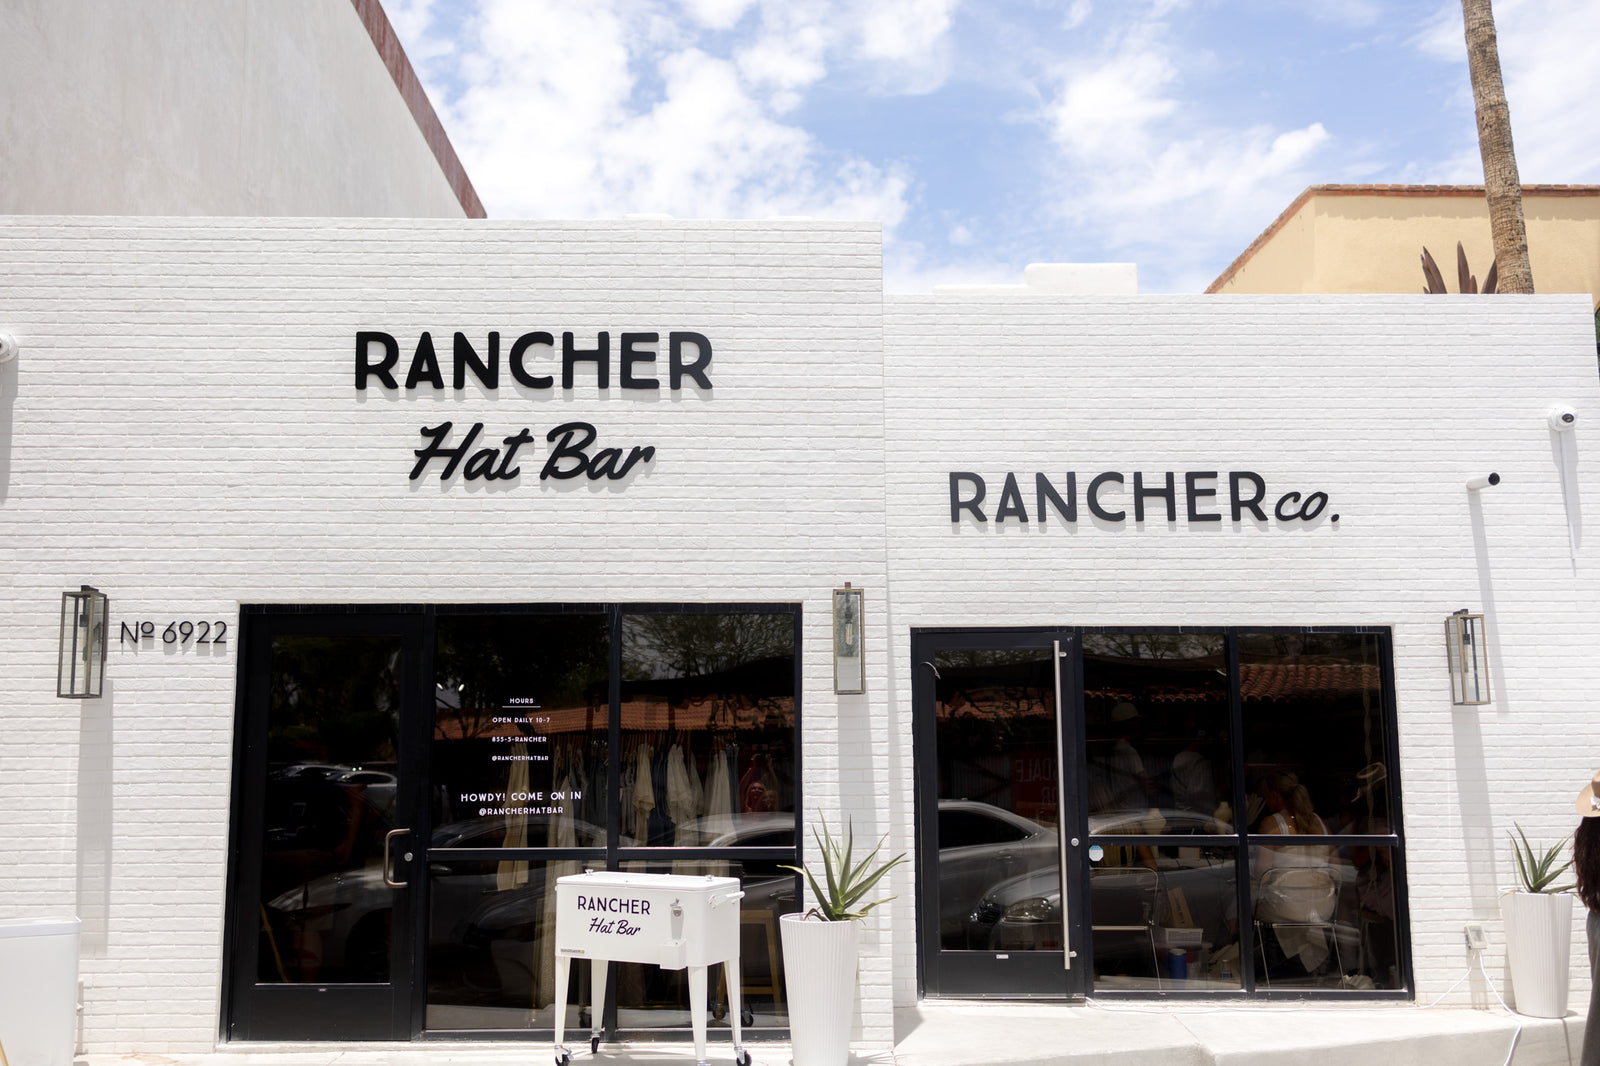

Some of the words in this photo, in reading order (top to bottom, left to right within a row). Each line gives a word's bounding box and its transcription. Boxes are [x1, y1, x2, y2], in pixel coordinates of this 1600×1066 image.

[355, 331, 713, 390] RANCHER
[408, 421, 534, 481] Hat
[539, 421, 656, 481] Bar
[162, 620, 227, 644] 6922
[460, 793, 506, 802] HOWDY!
[511, 792, 543, 801] COME
[550, 791, 565, 800] ON
[570, 791, 582, 800] IN
[478, 806, 564, 816] @RANCHERHATBAR
[577, 895, 651, 915] RANCHER
[588, 917, 616, 934] Hat
[616, 919, 641, 936] Bar
